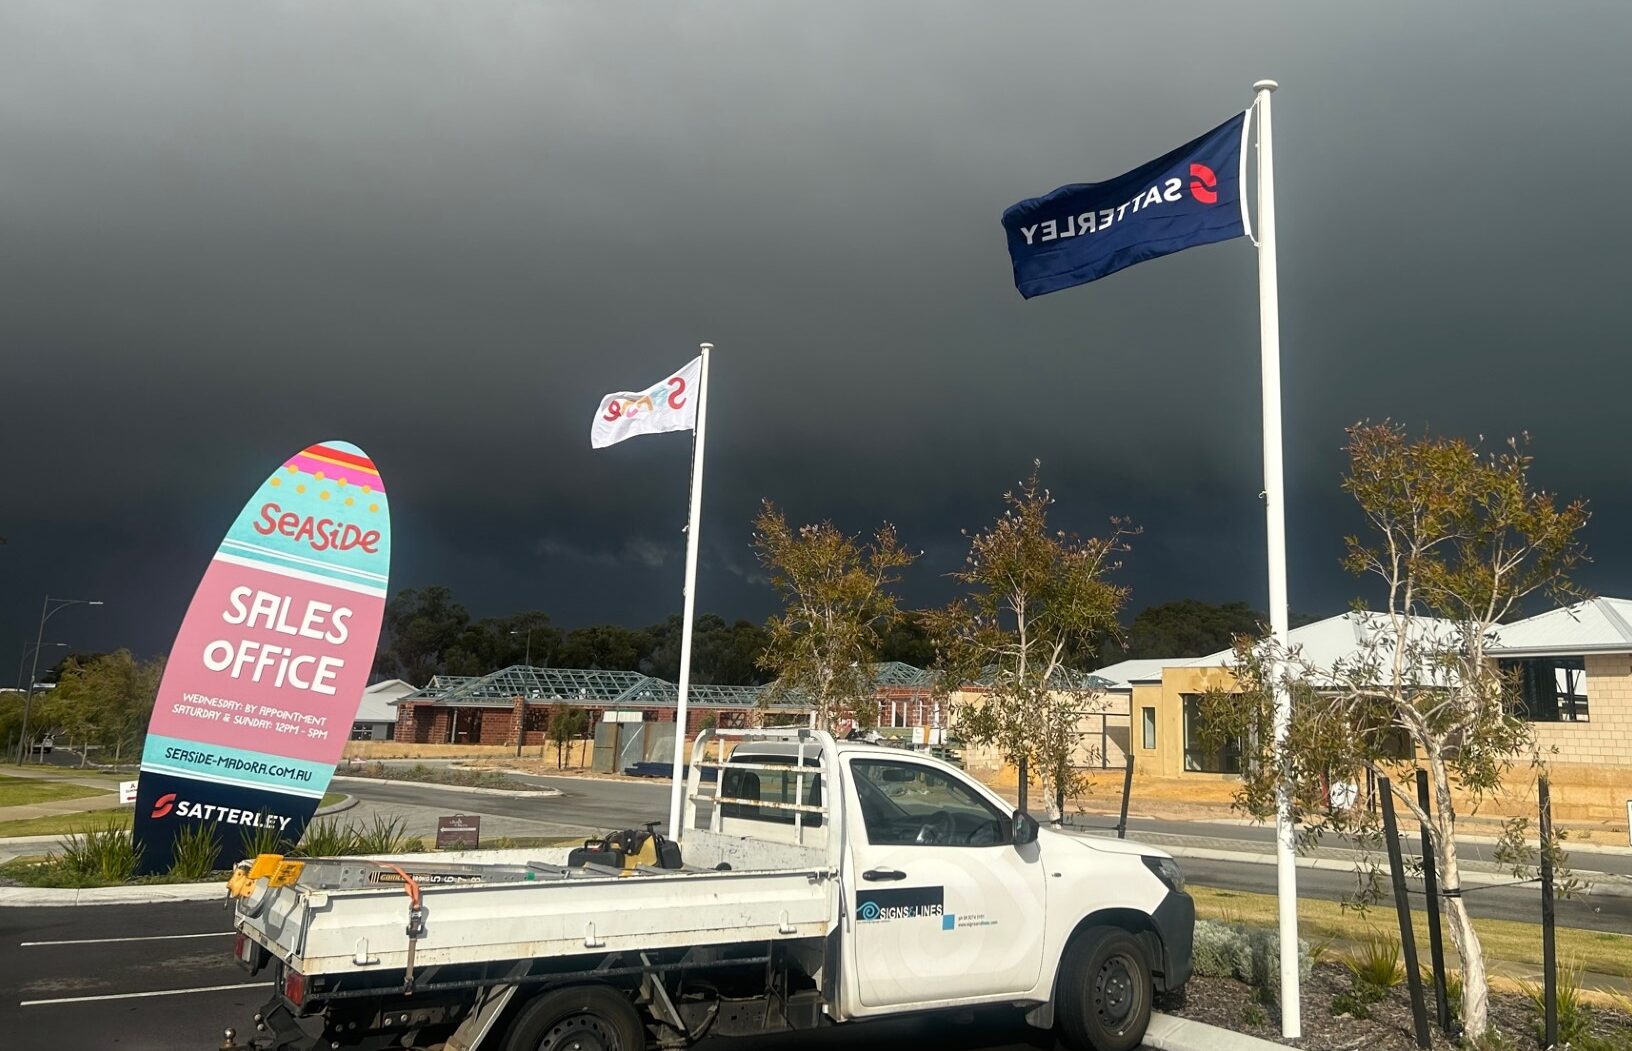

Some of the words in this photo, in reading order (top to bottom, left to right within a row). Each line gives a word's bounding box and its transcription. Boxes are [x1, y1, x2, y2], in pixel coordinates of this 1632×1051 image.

[222, 586, 354, 645] SALES
[171, 703, 222, 721] SATURDAY
[222, 713, 231, 722] &
[233, 714, 273, 730] SUNDAY:
[275, 721, 300, 735] 12PM
[307, 728, 328, 740] 5PM
[183, 692, 244, 711] WEDNESDAY:
[244, 704, 258, 714] BY
[259, 705, 328, 727] APPOINTMENT
[175, 800, 292, 832] SATTERLEY
